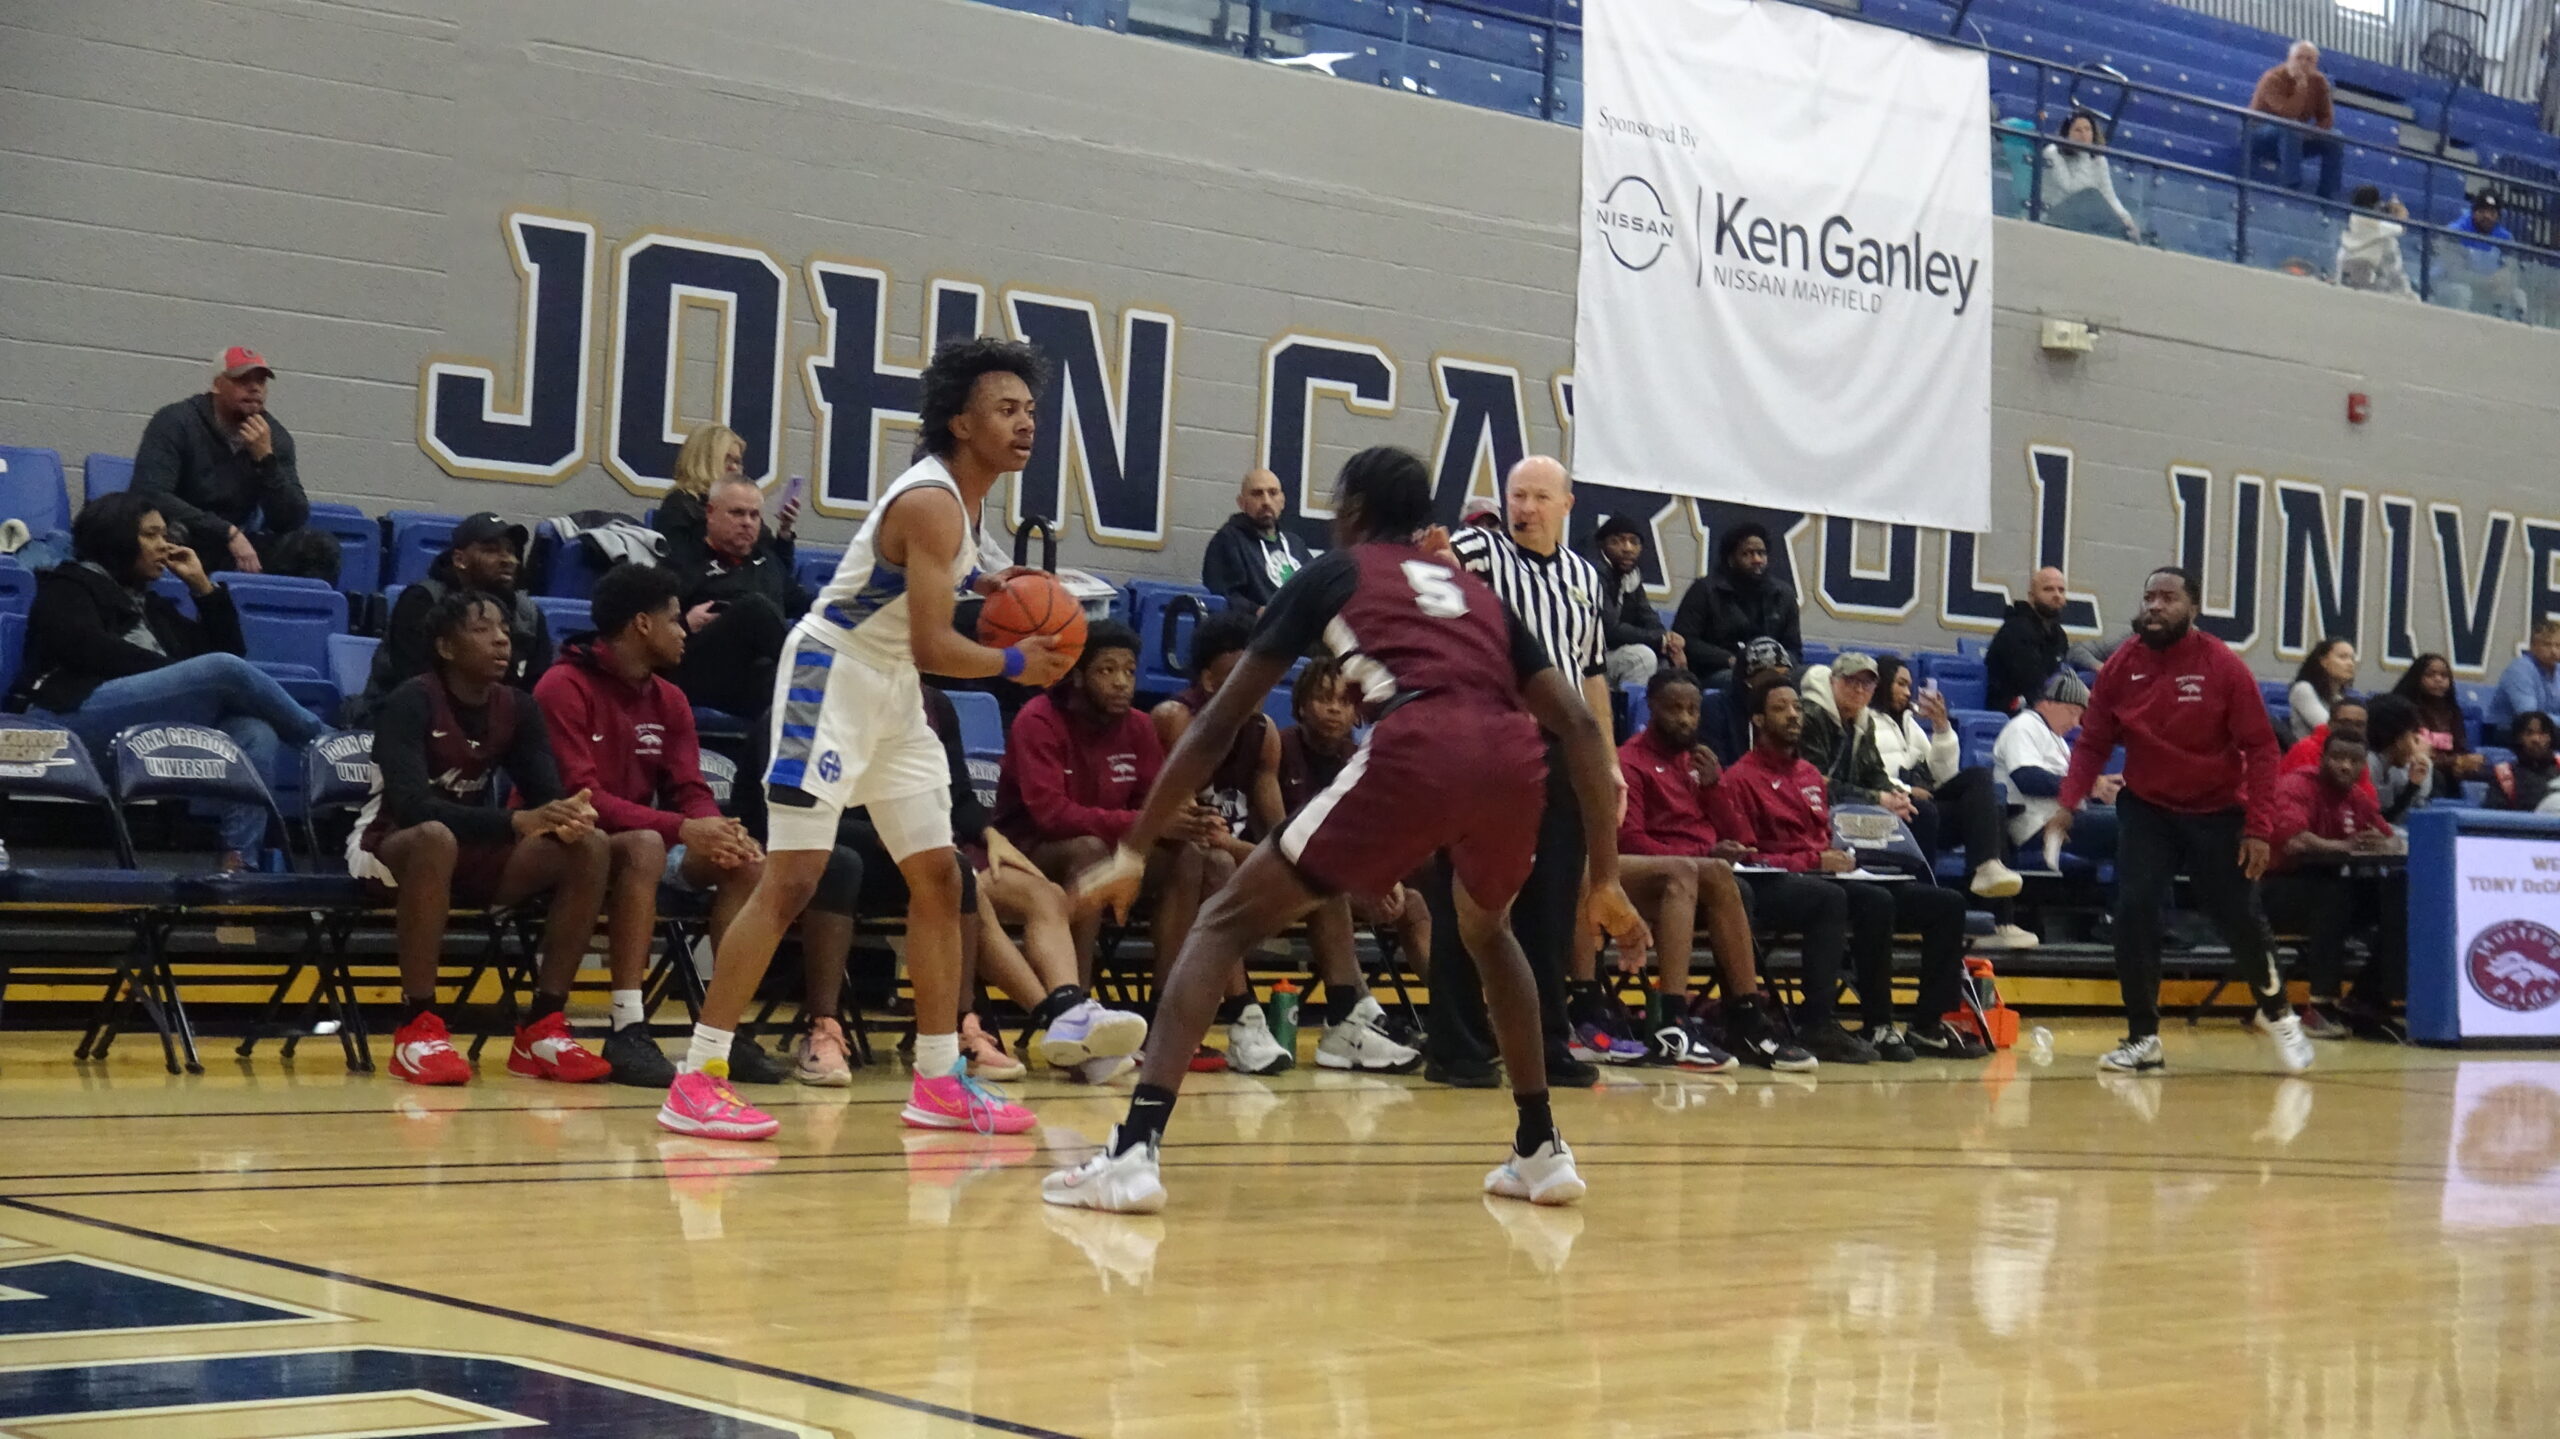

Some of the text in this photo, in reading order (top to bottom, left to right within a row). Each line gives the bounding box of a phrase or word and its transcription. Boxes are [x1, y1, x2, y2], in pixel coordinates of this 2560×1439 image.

[1597, 106, 1700, 152] Sponsored By
[1596, 208, 1675, 239] NISSAN
[1714, 192, 1980, 316] Ken Ganley
[1713, 265, 1883, 315] NISSAN MAYFIELD
[420, 208, 1180, 547] JOHN
[1400, 559, 1468, 619] 5
[125, 727, 169, 760] JOHN
[318, 734, 362, 766] JOHN
[144, 756, 227, 779] UNIVERSITY
[2466, 876, 2516, 893] TONY
